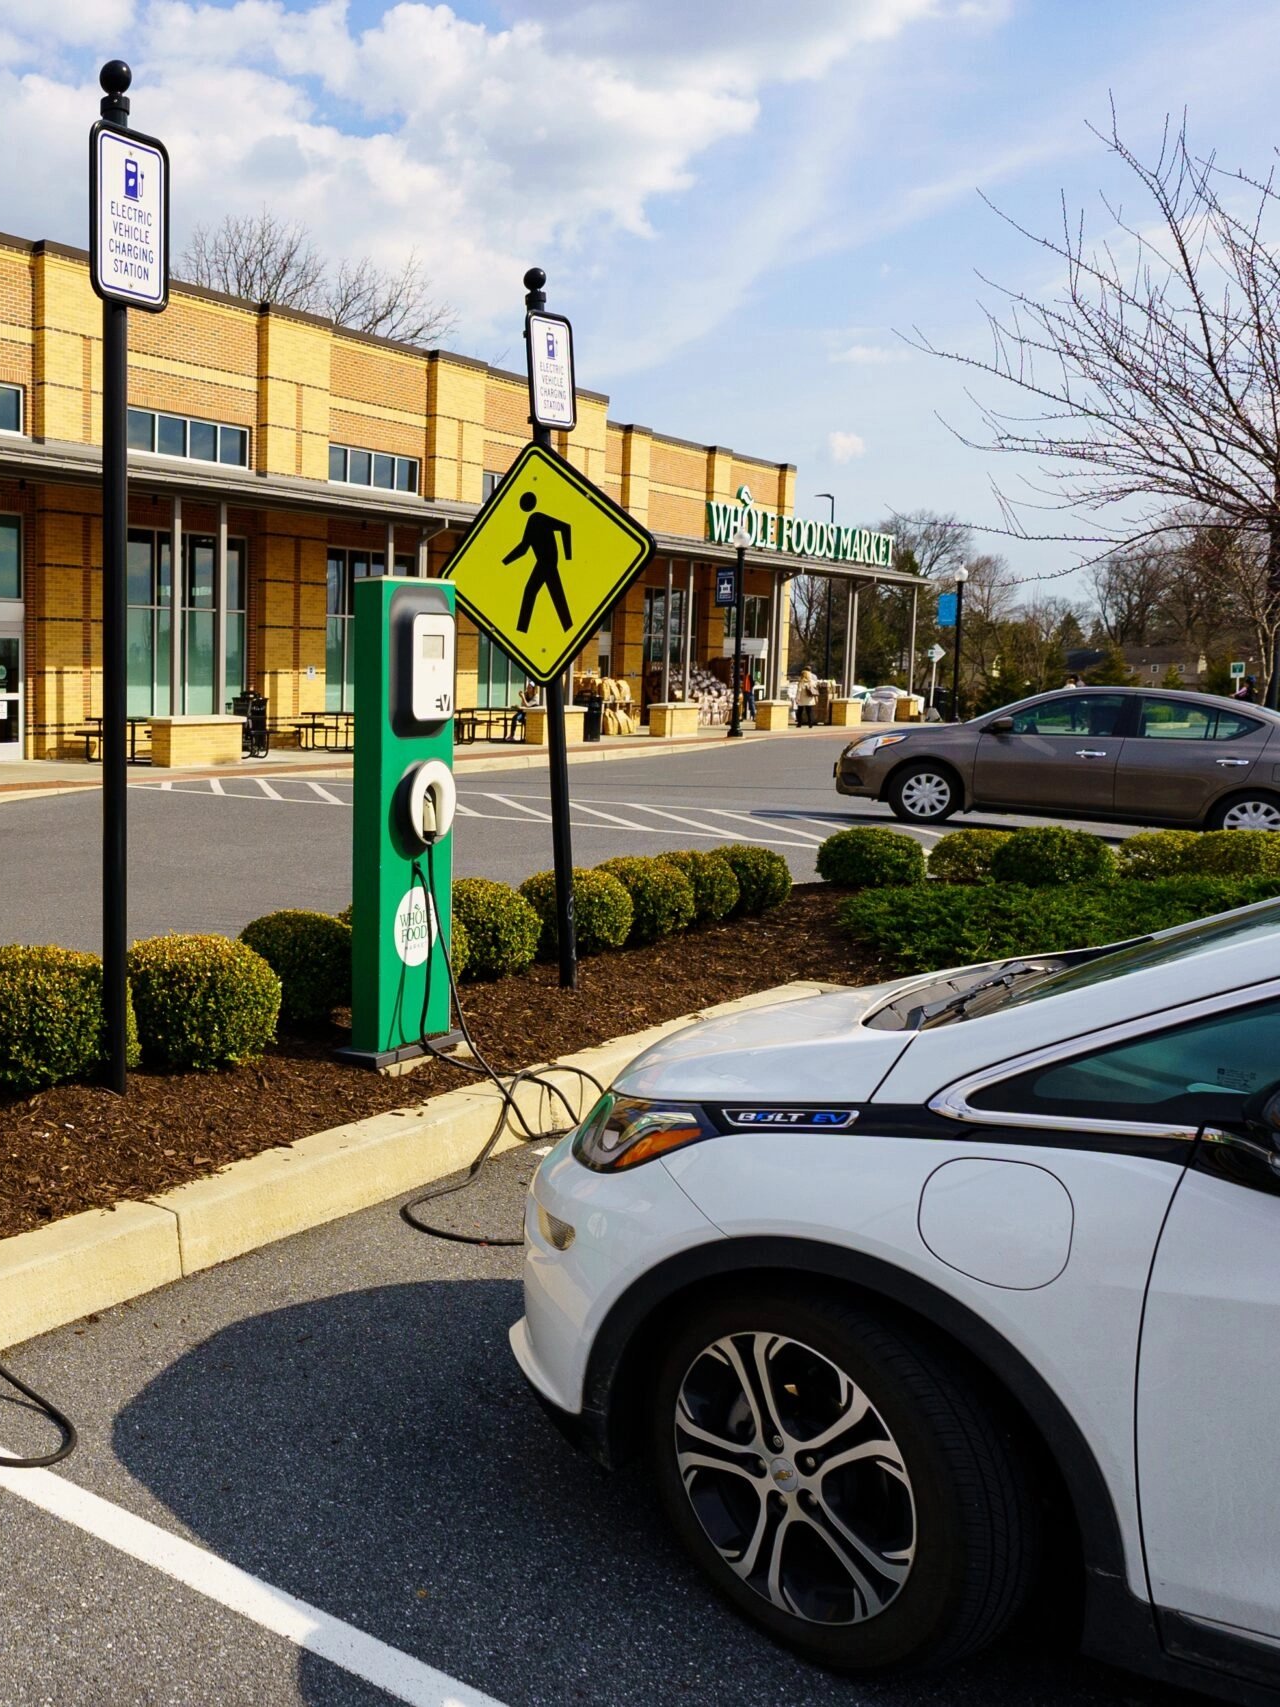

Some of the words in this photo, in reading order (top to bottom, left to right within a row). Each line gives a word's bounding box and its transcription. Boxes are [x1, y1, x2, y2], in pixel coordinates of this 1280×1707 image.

[110, 200, 152, 227] ELECTRIC
[113, 220, 150, 245] VEHICLE
[108, 238, 154, 264] CHARGING
[113, 258, 149, 281] STATION
[539, 361, 564, 376] ELECTRIC
[541, 374, 564, 388] VEHICLE
[540, 386, 567, 400] CHARGING
[544, 399, 565, 411] STATION
[708, 501, 778, 550] WHOLE
[781, 515, 836, 559] FOODS
[838, 527, 895, 567] MARKET
[738, 1112, 805, 1122] BOLT
[812, 1112, 847, 1123] EV
